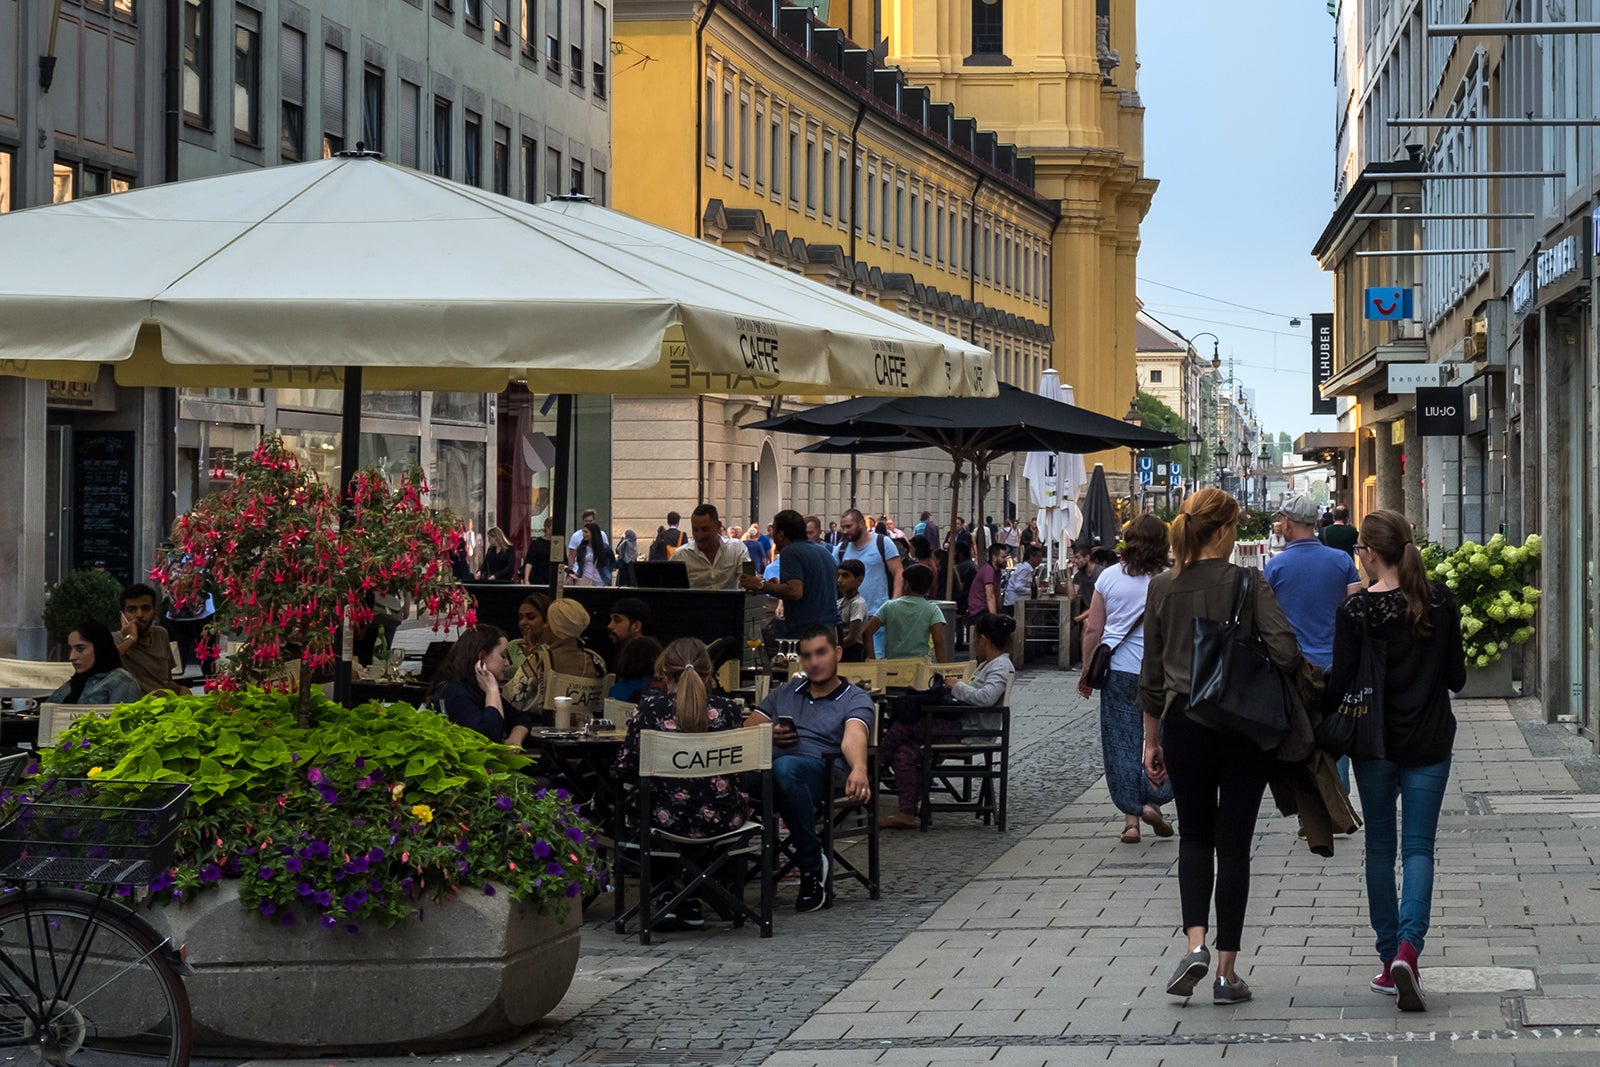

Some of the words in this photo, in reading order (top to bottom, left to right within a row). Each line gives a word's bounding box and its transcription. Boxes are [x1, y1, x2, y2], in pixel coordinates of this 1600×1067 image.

[1320, 326, 1330, 401] LHUBER
[1141, 458, 1152, 471] U
[1171, 465, 1180, 475] U
